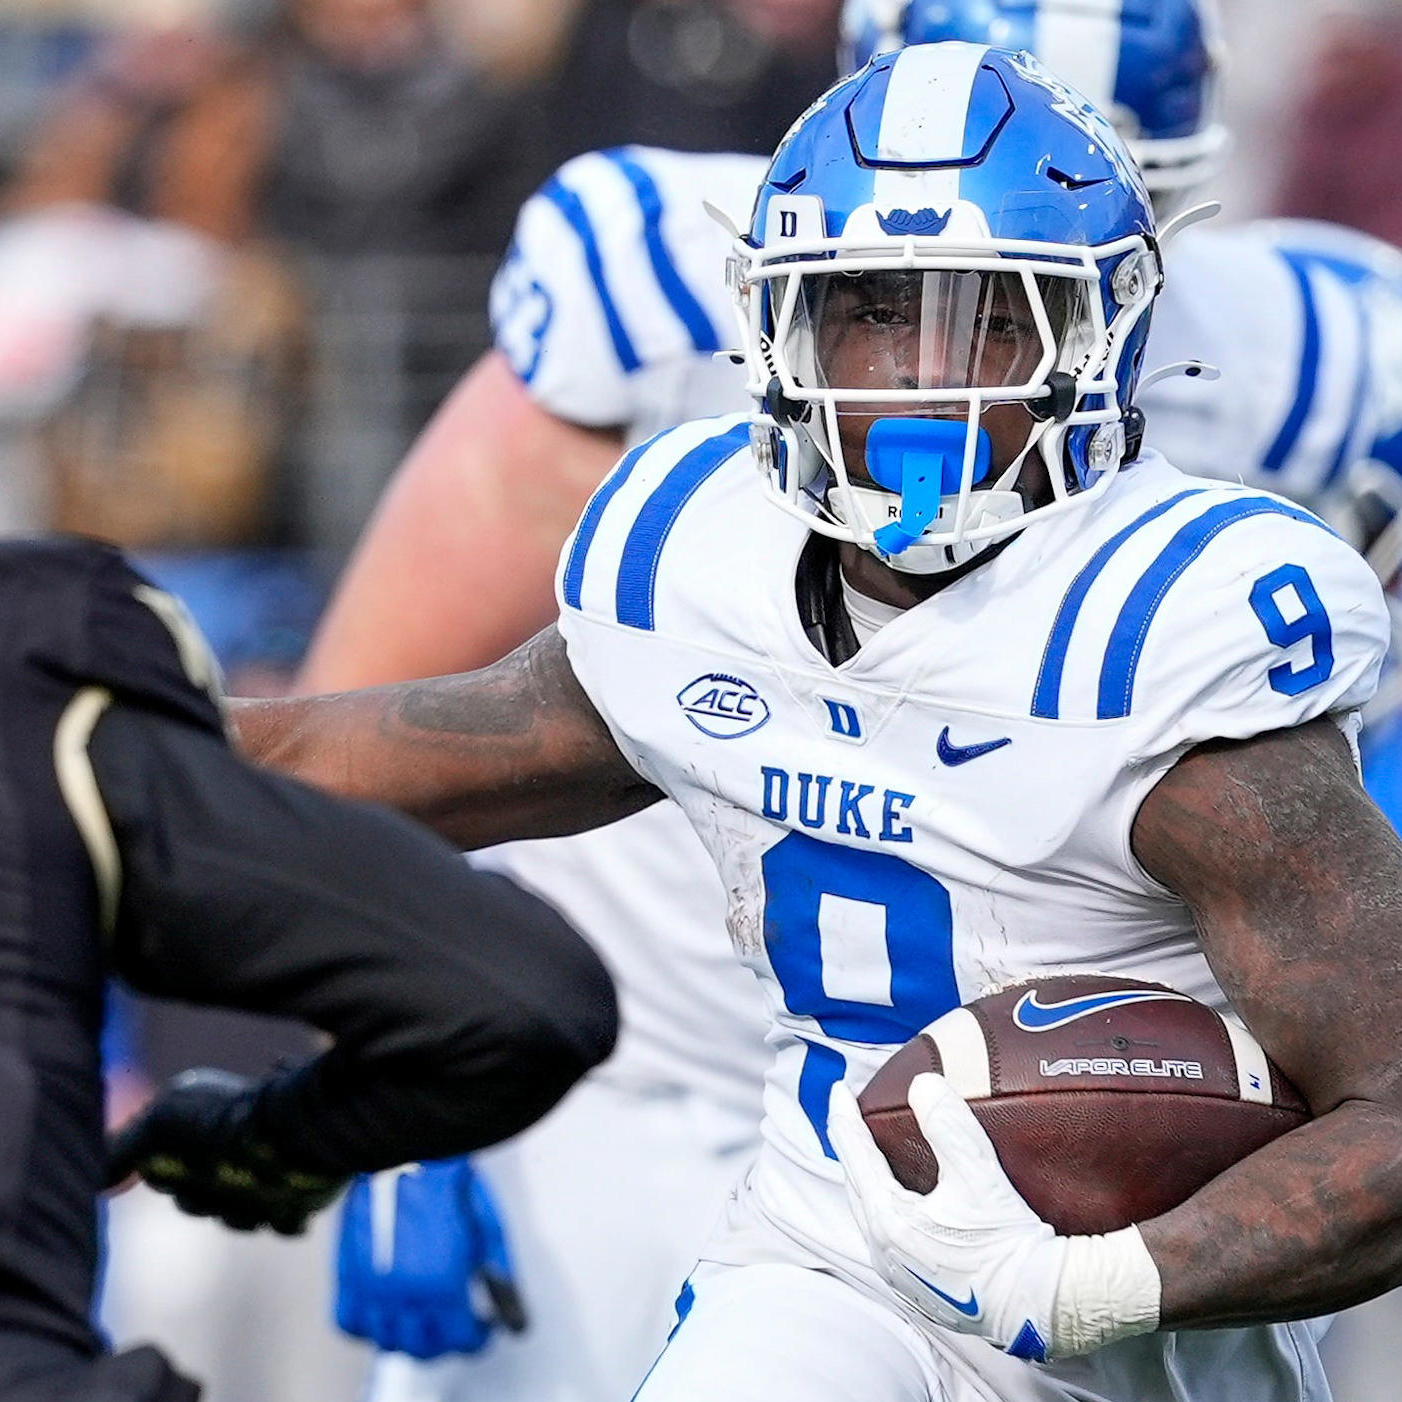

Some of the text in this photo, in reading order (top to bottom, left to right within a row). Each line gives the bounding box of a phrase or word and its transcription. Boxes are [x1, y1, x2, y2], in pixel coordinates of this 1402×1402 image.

[779, 210, 798, 238] D
[1248, 563, 1334, 696] 9
[692, 687, 759, 717] ACC
[823, 698, 862, 738] D
[760, 765, 916, 843] DUKE
[760, 829, 962, 1161] 9
[1039, 1058, 1204, 1080] VAPOR ELITE
